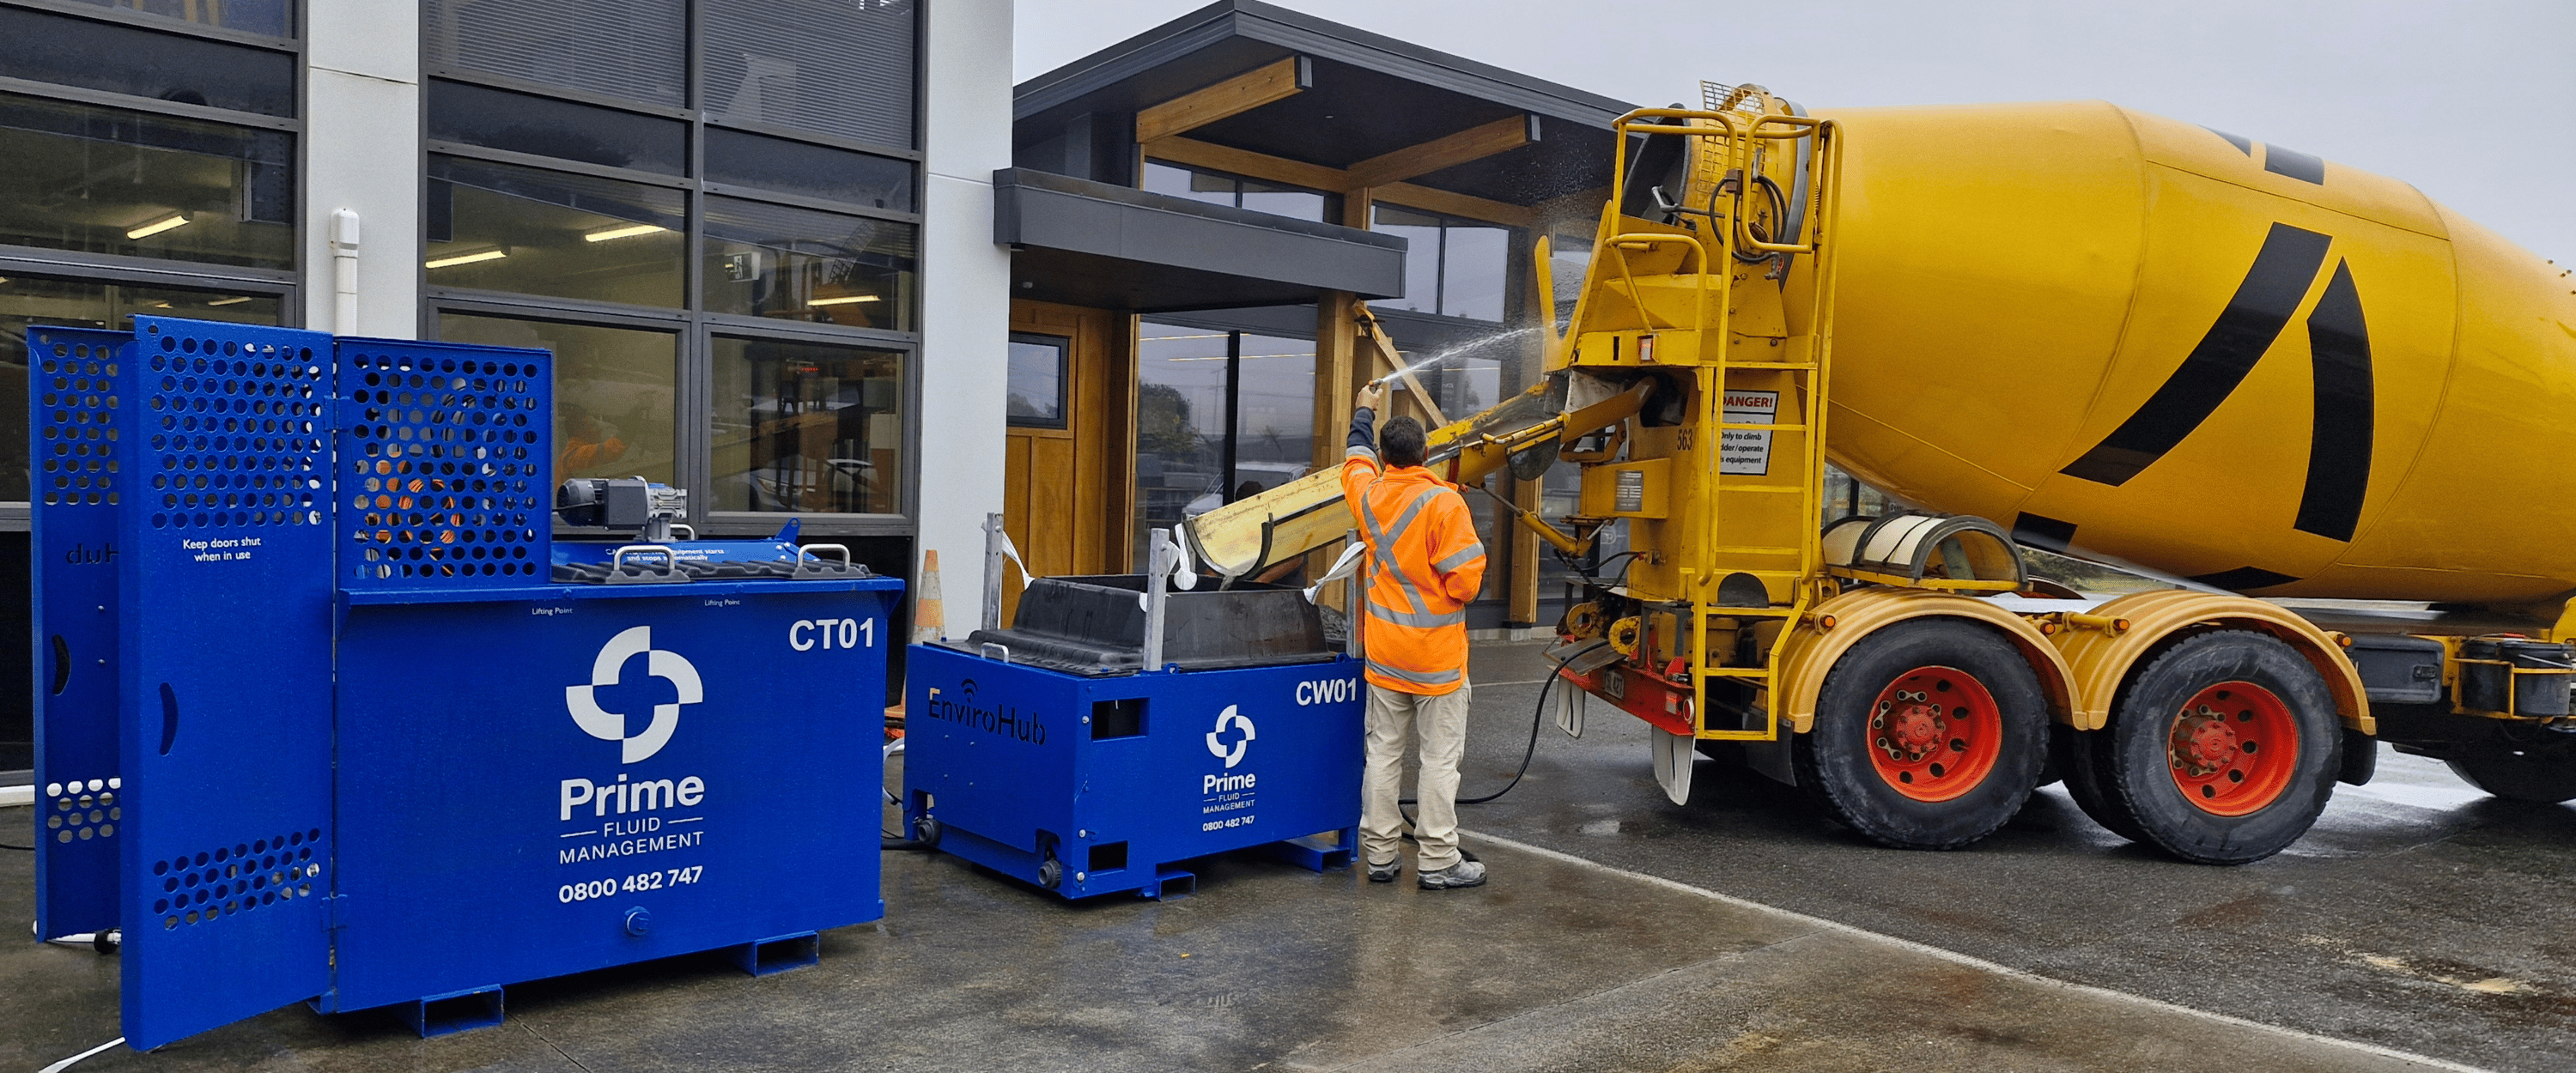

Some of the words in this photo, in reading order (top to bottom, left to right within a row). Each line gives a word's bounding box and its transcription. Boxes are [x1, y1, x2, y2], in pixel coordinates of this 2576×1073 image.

[1677, 428, 1692, 451] 563
[183, 539, 208, 551] Keep
[210, 537, 239, 548] doors
[240, 536, 261, 547] shut
[194, 551, 221, 561] when
[223, 551, 232, 560] in
[235, 551, 251, 560] use
[532, 608, 553, 616] Lifting
[704, 598, 723, 607] Lifting
[789, 617, 873, 652] CT01
[1296, 677, 1357, 706] CW01
[928, 687, 1046, 746] EnviroHub
[1203, 773, 1256, 795] Prime
[560, 773, 705, 821] Prime
[1203, 799, 1255, 815] MANAGEMENT
[1218, 792, 1240, 803] FLUID
[604, 817, 660, 838] FLUID
[1202, 821, 1224, 832] 0800
[1224, 817, 1240, 828] 482
[1241, 815, 1255, 826] 747
[559, 831, 704, 864] MANAGEMENT
[558, 878, 617, 903] 0800
[622, 871, 663, 893] 482
[667, 865, 703, 887] 747
